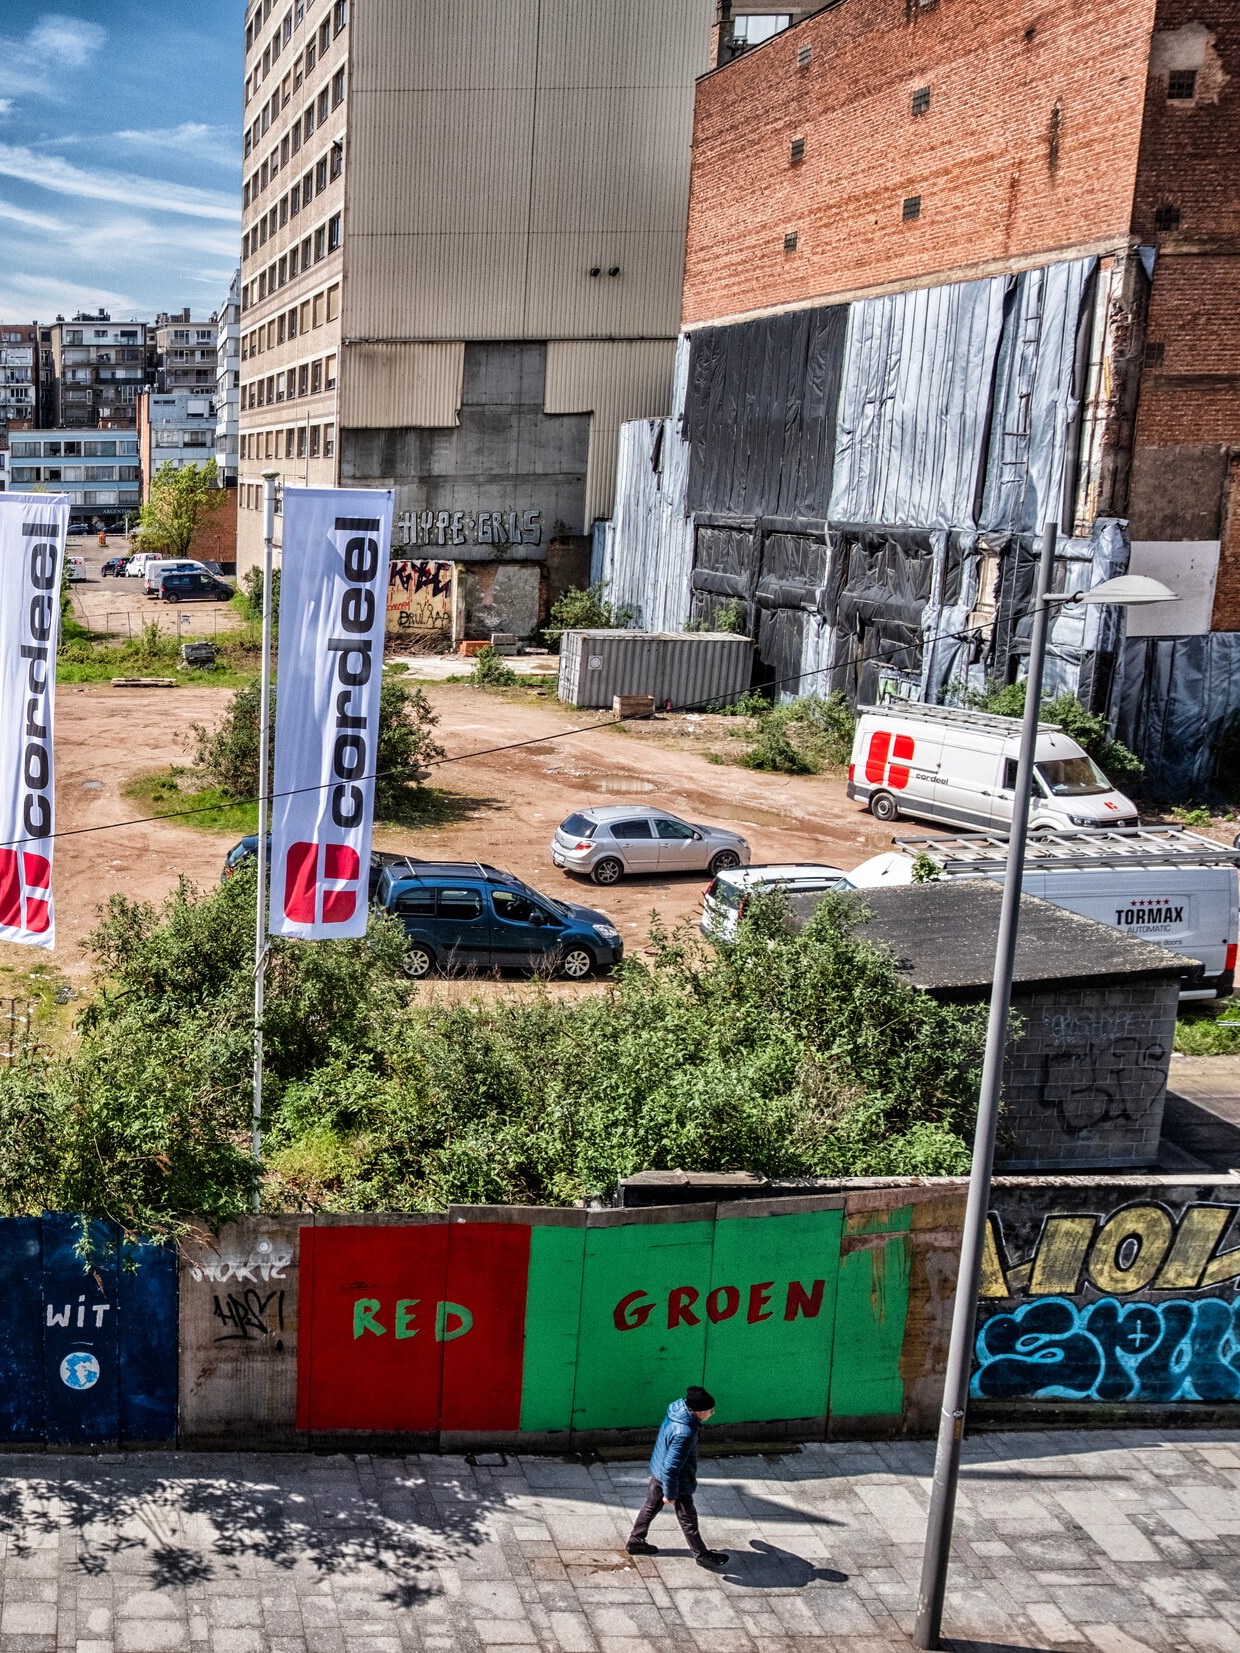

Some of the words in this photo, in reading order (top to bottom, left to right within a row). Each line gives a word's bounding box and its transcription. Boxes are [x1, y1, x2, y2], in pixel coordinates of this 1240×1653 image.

[478, 510, 541, 546] GRLS
[21, 523, 59, 838] cordeel
[328, 517, 380, 828] cordeel
[915, 772, 949, 785] cordeel
[1115, 906, 1184, 925] TORMAX
[1127, 925, 1171, 933] AUTOMATIC
[353, 1298, 473, 1342] RED
[613, 1279, 826, 1332] GROEN
